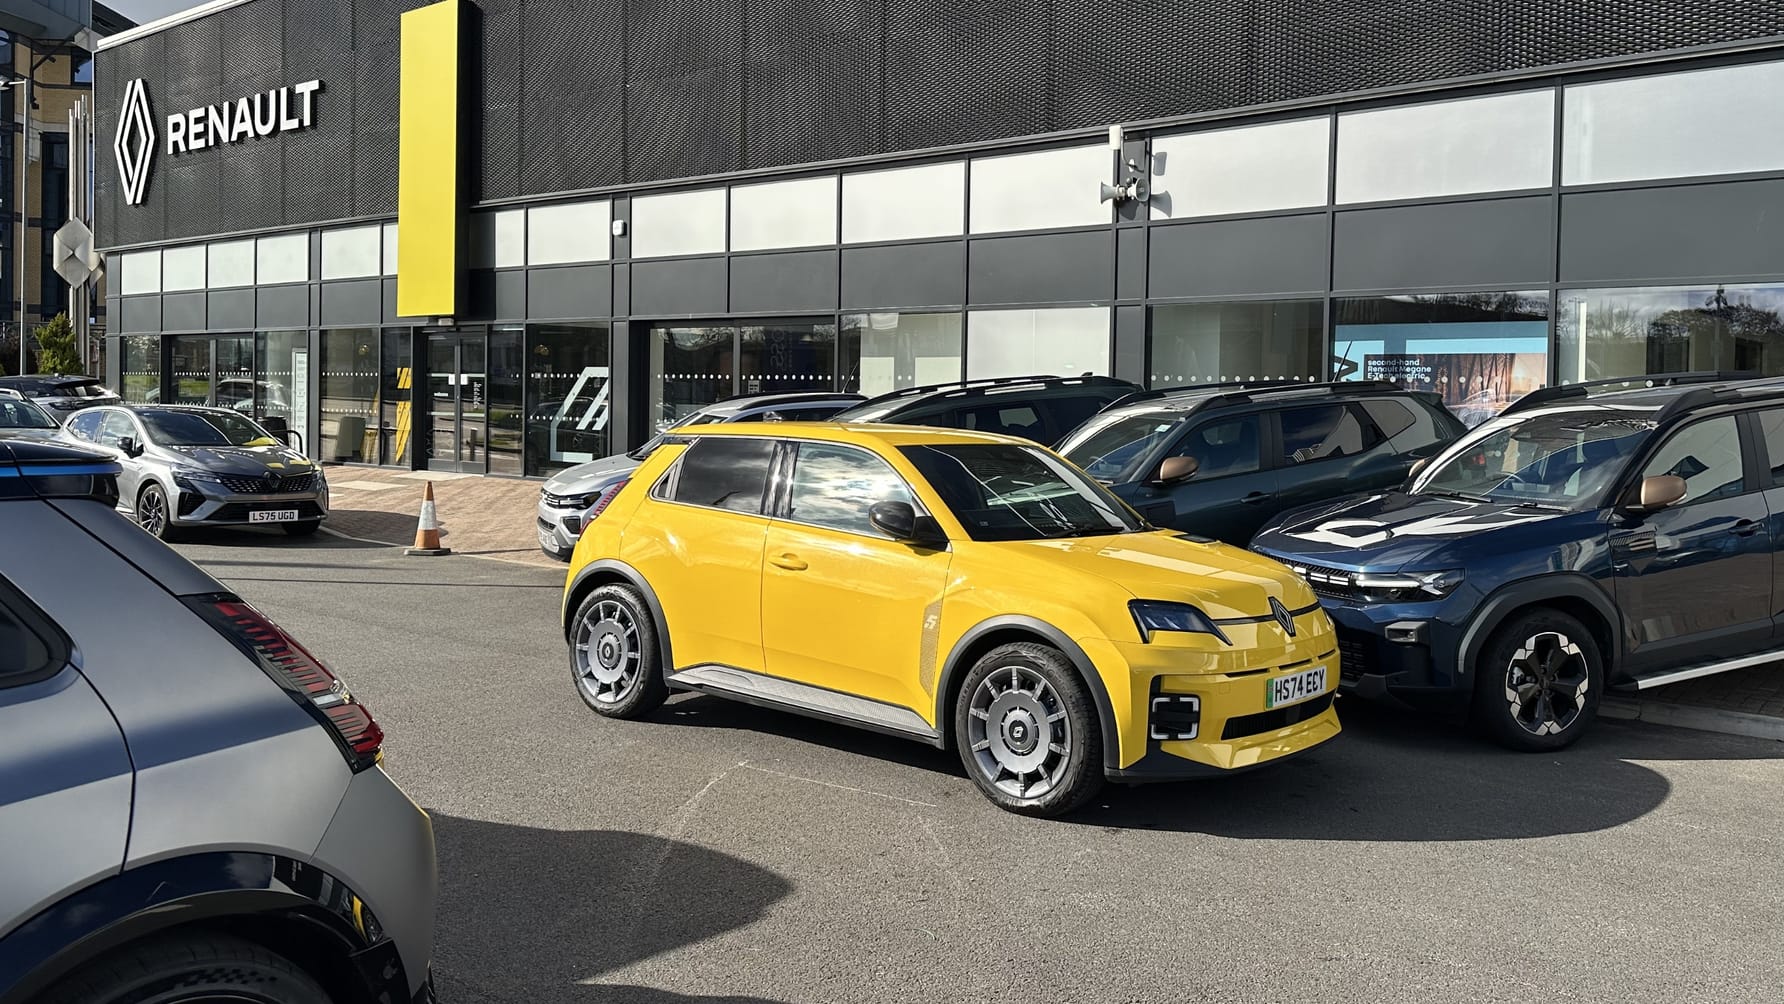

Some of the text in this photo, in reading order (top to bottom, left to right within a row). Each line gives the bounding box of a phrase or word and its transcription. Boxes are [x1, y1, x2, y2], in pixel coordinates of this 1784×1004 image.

[168, 80, 319, 155] RENAULT
[252, 511, 295, 521] LS75 UGD
[1275, 668, 1325, 703] HS74 ECY
